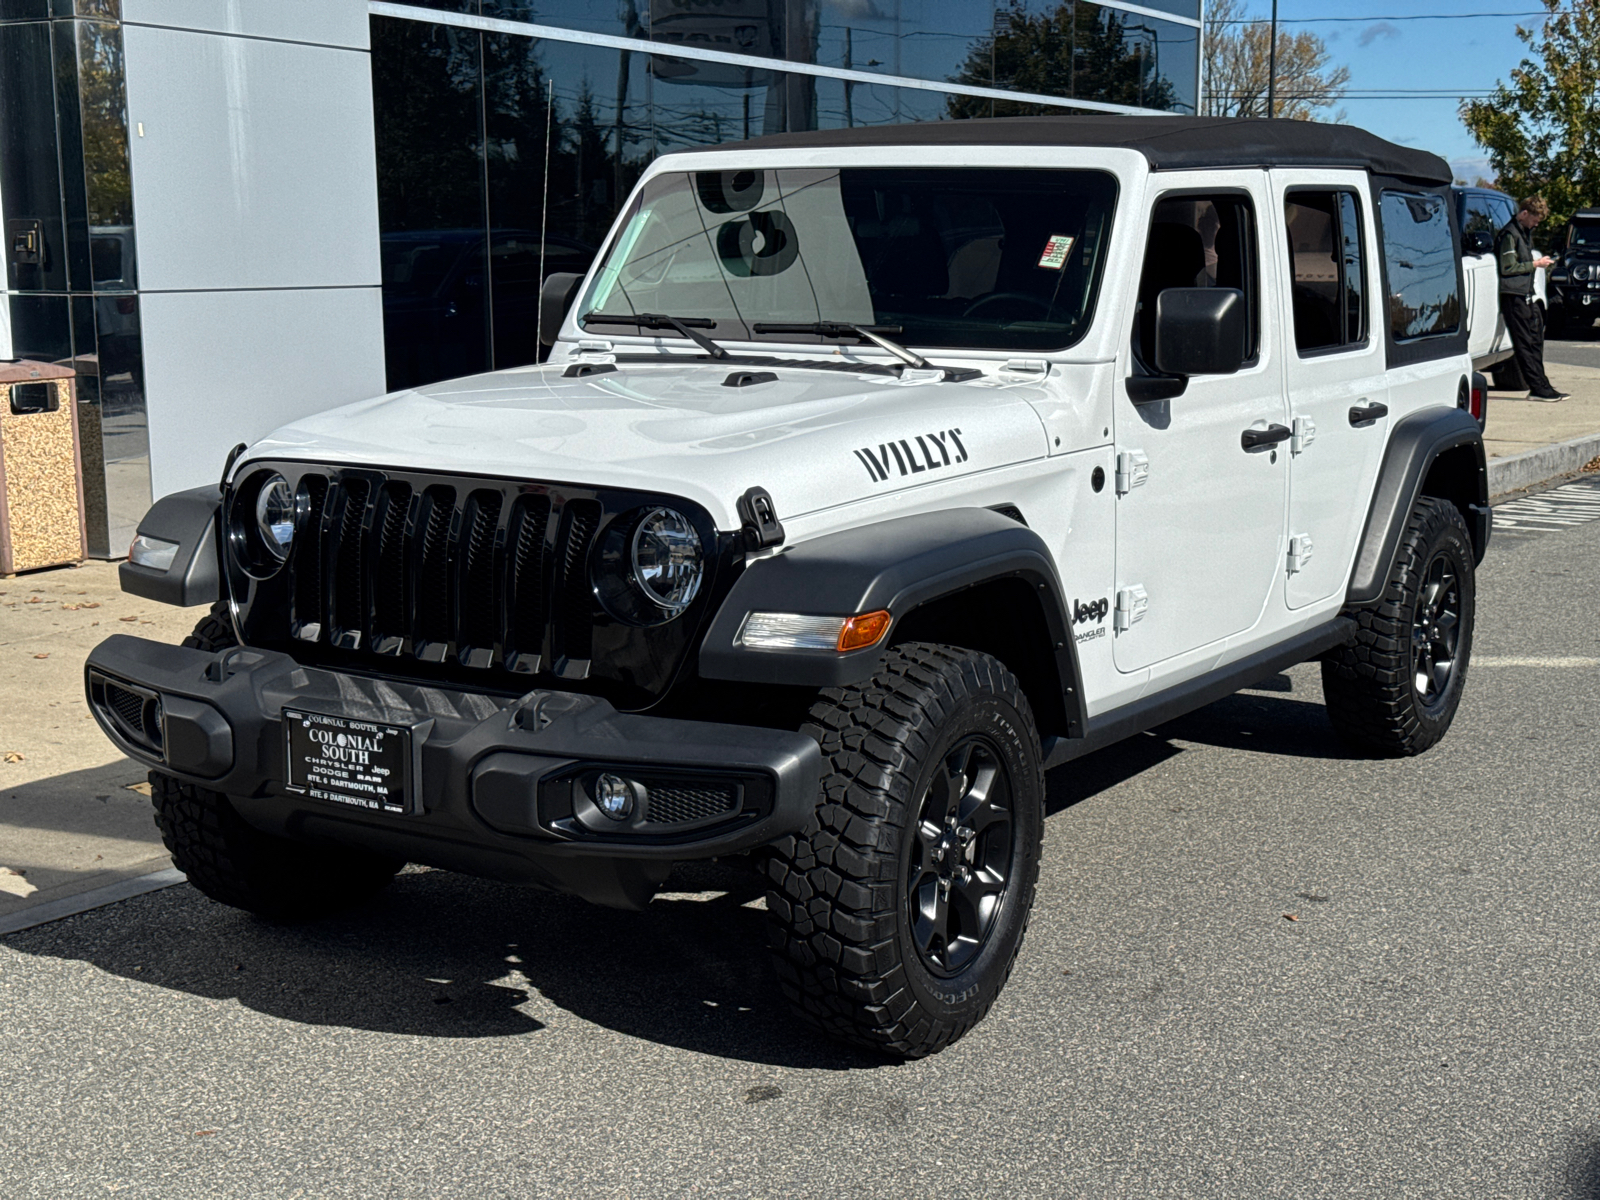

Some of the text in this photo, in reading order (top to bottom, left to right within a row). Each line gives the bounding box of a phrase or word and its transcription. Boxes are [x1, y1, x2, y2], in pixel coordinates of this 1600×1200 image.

[853, 428, 969, 483] WILLYS
[1071, 597, 1109, 626] Jeep
[308, 715, 346, 728] COLONIAL
[349, 722, 378, 733] SOUTH
[309, 728, 383, 752] COLONIAL
[322, 745, 370, 764] SOUTH
[304, 756, 390, 776] CHRYSLER Jeep
[312, 766, 382, 783] DODGE RAM
[376, 786, 389, 795] MA
[368, 801, 379, 809] MA
